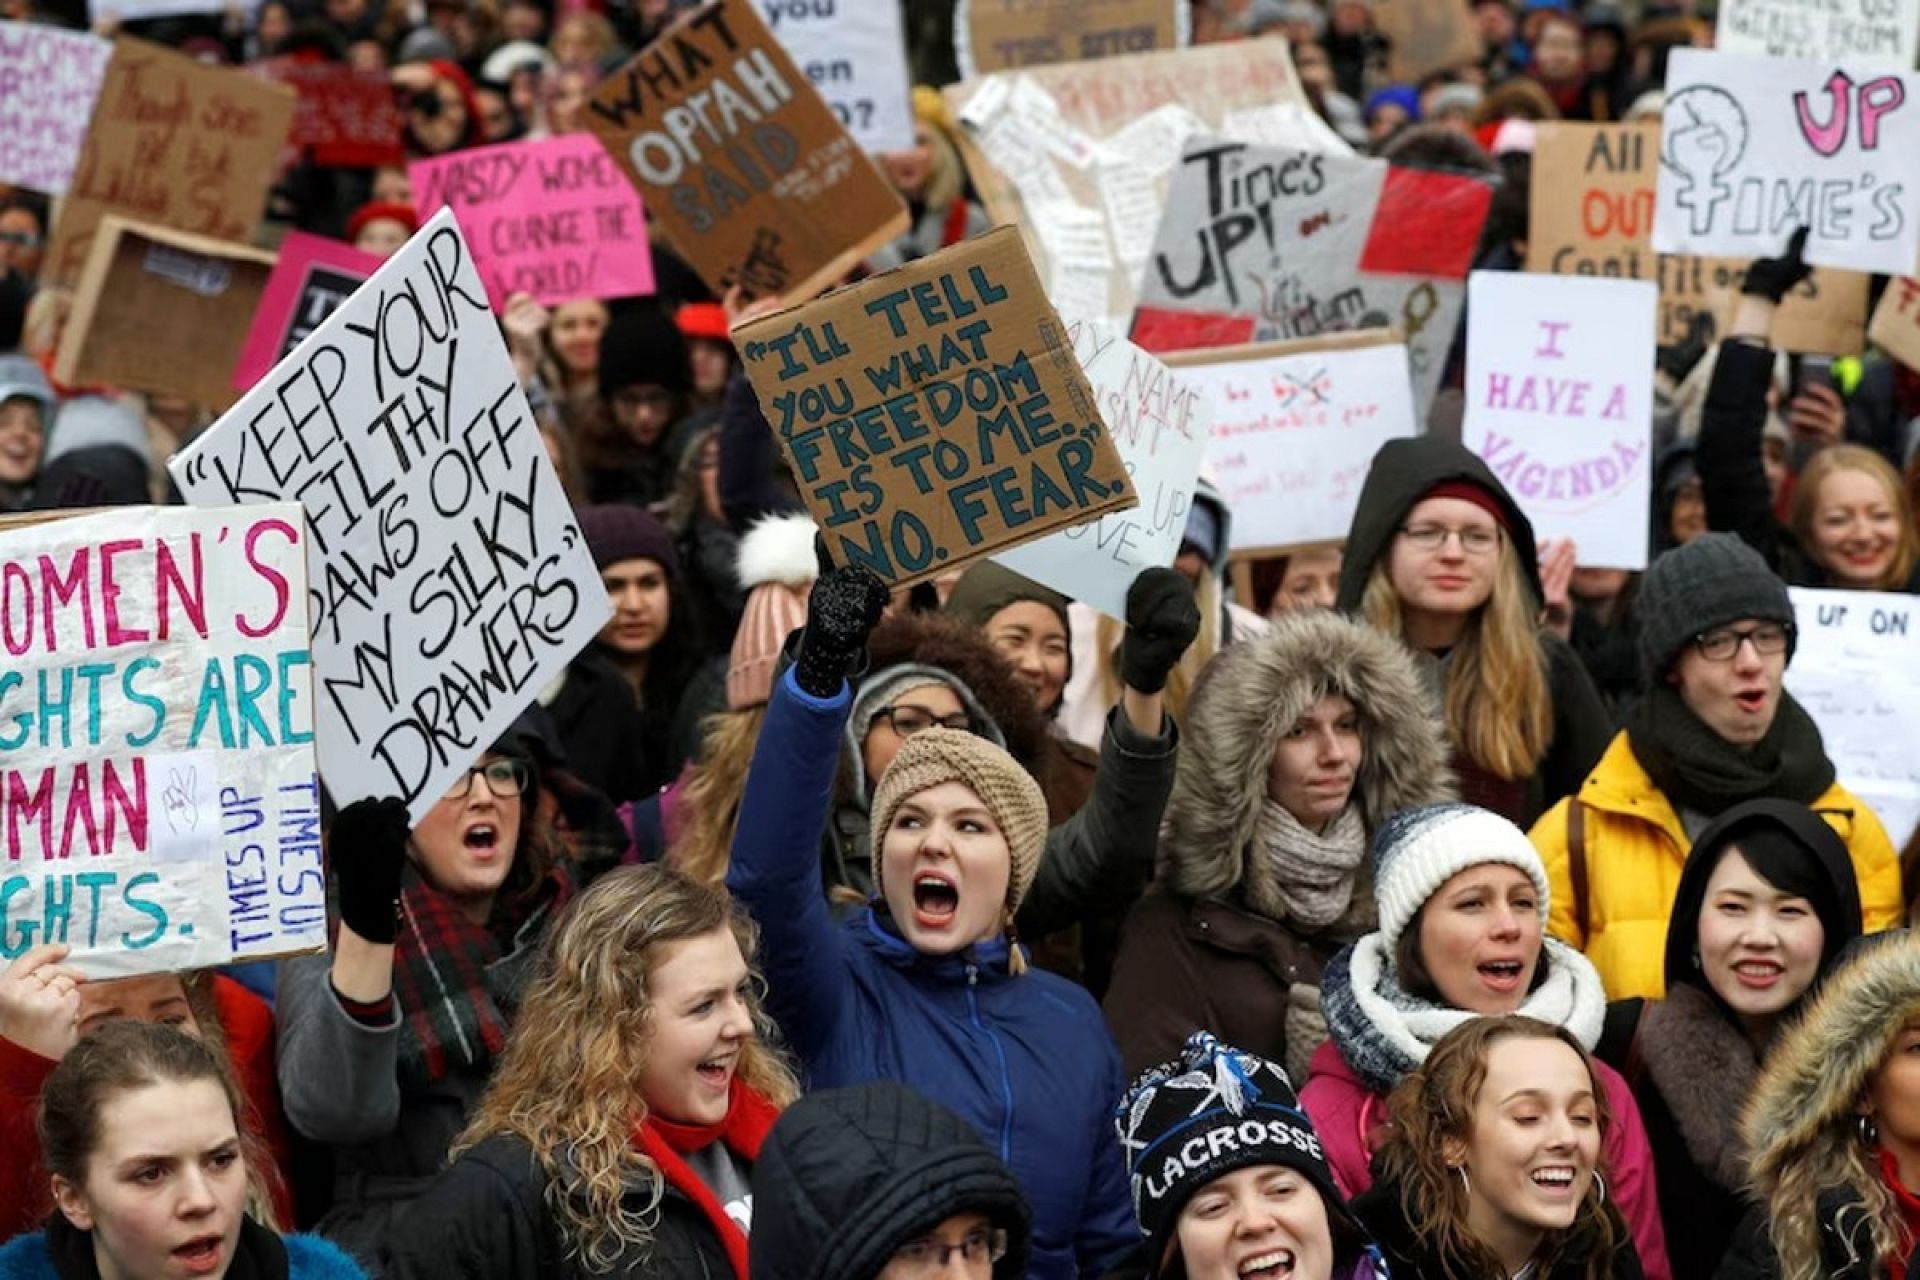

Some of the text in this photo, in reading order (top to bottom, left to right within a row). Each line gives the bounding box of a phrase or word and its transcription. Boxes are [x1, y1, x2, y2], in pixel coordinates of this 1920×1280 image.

[591, 2, 738, 128] WHAT
[1585, 131, 1645, 173] All
[1793, 69, 1905, 158] UP
[421, 151, 622, 215] NASTY WOME
[669, 123, 799, 233] SAID
[490, 206, 586, 256] CHANGE
[594, 204, 634, 241] THE
[864, 265, 1009, 339] TELL
[1534, 320, 1572, 360] I
[186, 224, 490, 503] "KEEP YOUR
[772, 377, 855, 438] YOU
[864, 319, 993, 396] WHAT
[1484, 371, 1628, 421] HAVE A
[294, 338, 458, 555] FILTHY
[430, 382, 523, 518] OFF
[789, 350, 1041, 484] FREEDOM
[814, 464, 885, 528] IS
[891, 439, 970, 496] TO
[2, 518, 299, 656] OMEN'S
[840, 510, 949, 580] NO.
[324, 456, 539, 745] MY SILKY
[1817, 604, 1910, 636] UP ON
[0, 650, 315, 751] GHTS ARE
[1, 756, 149, 861] MAN
[220, 785, 266, 837] UP
[0, 871, 195, 961] GHTS.
[1145, 1119, 1324, 1199] LACROSSE
